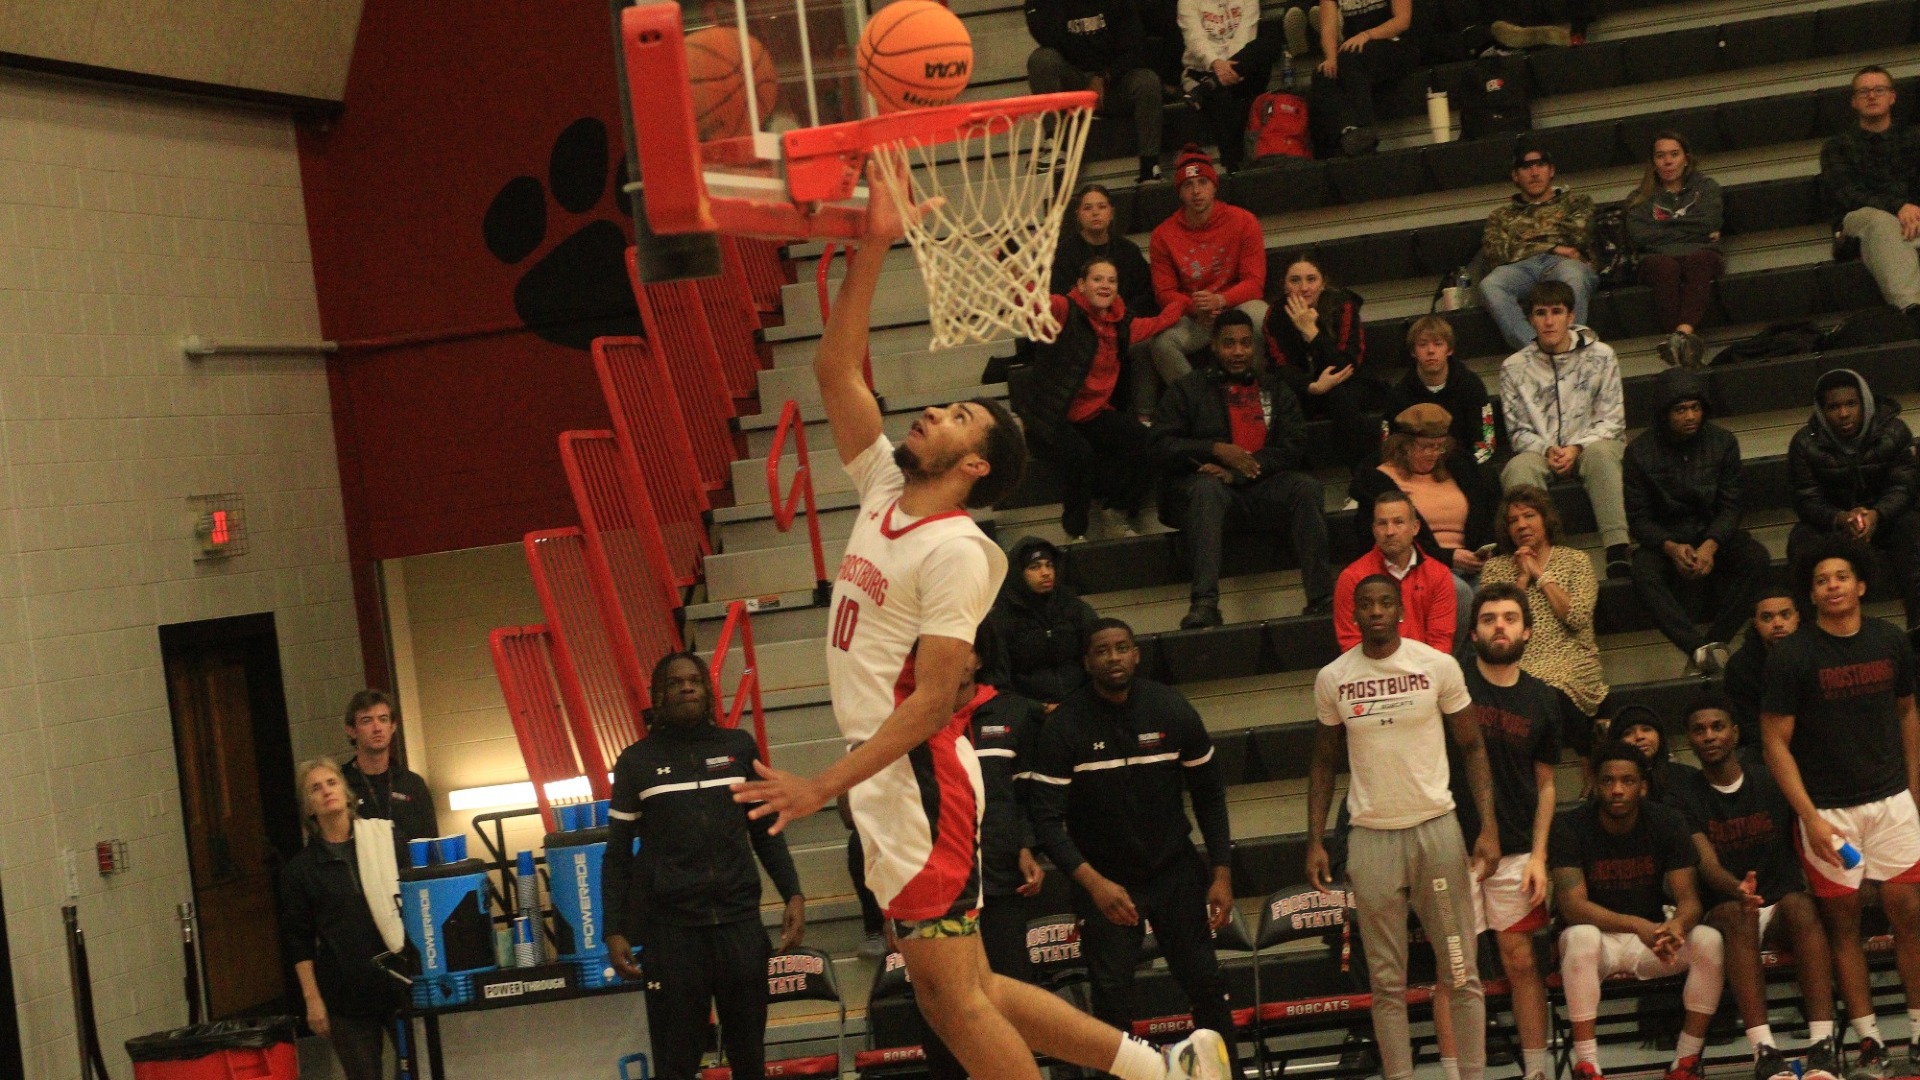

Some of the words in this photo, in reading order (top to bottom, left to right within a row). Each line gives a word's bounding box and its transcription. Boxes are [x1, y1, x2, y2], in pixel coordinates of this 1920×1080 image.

[925, 61, 967, 79] NCAA
[832, 595, 859, 652] 10
[1338, 673, 1430, 702] FROSTBURG
[573, 853, 596, 949] POWERADE
[418, 888, 438, 970] POWERADE
[1290, 907, 1344, 930] STATE
[1028, 941, 1082, 964] STATE
[767, 954, 824, 975] STBURG
[485, 982, 522, 997] POWER
[523, 977, 566, 993] THROUGH
[767, 973, 807, 995] TATE
[1286, 999, 1350, 1016] BOBCATS
[1148, 1019, 1195, 1034] BOBCA
[883, 1048, 927, 1061] BOBCA
